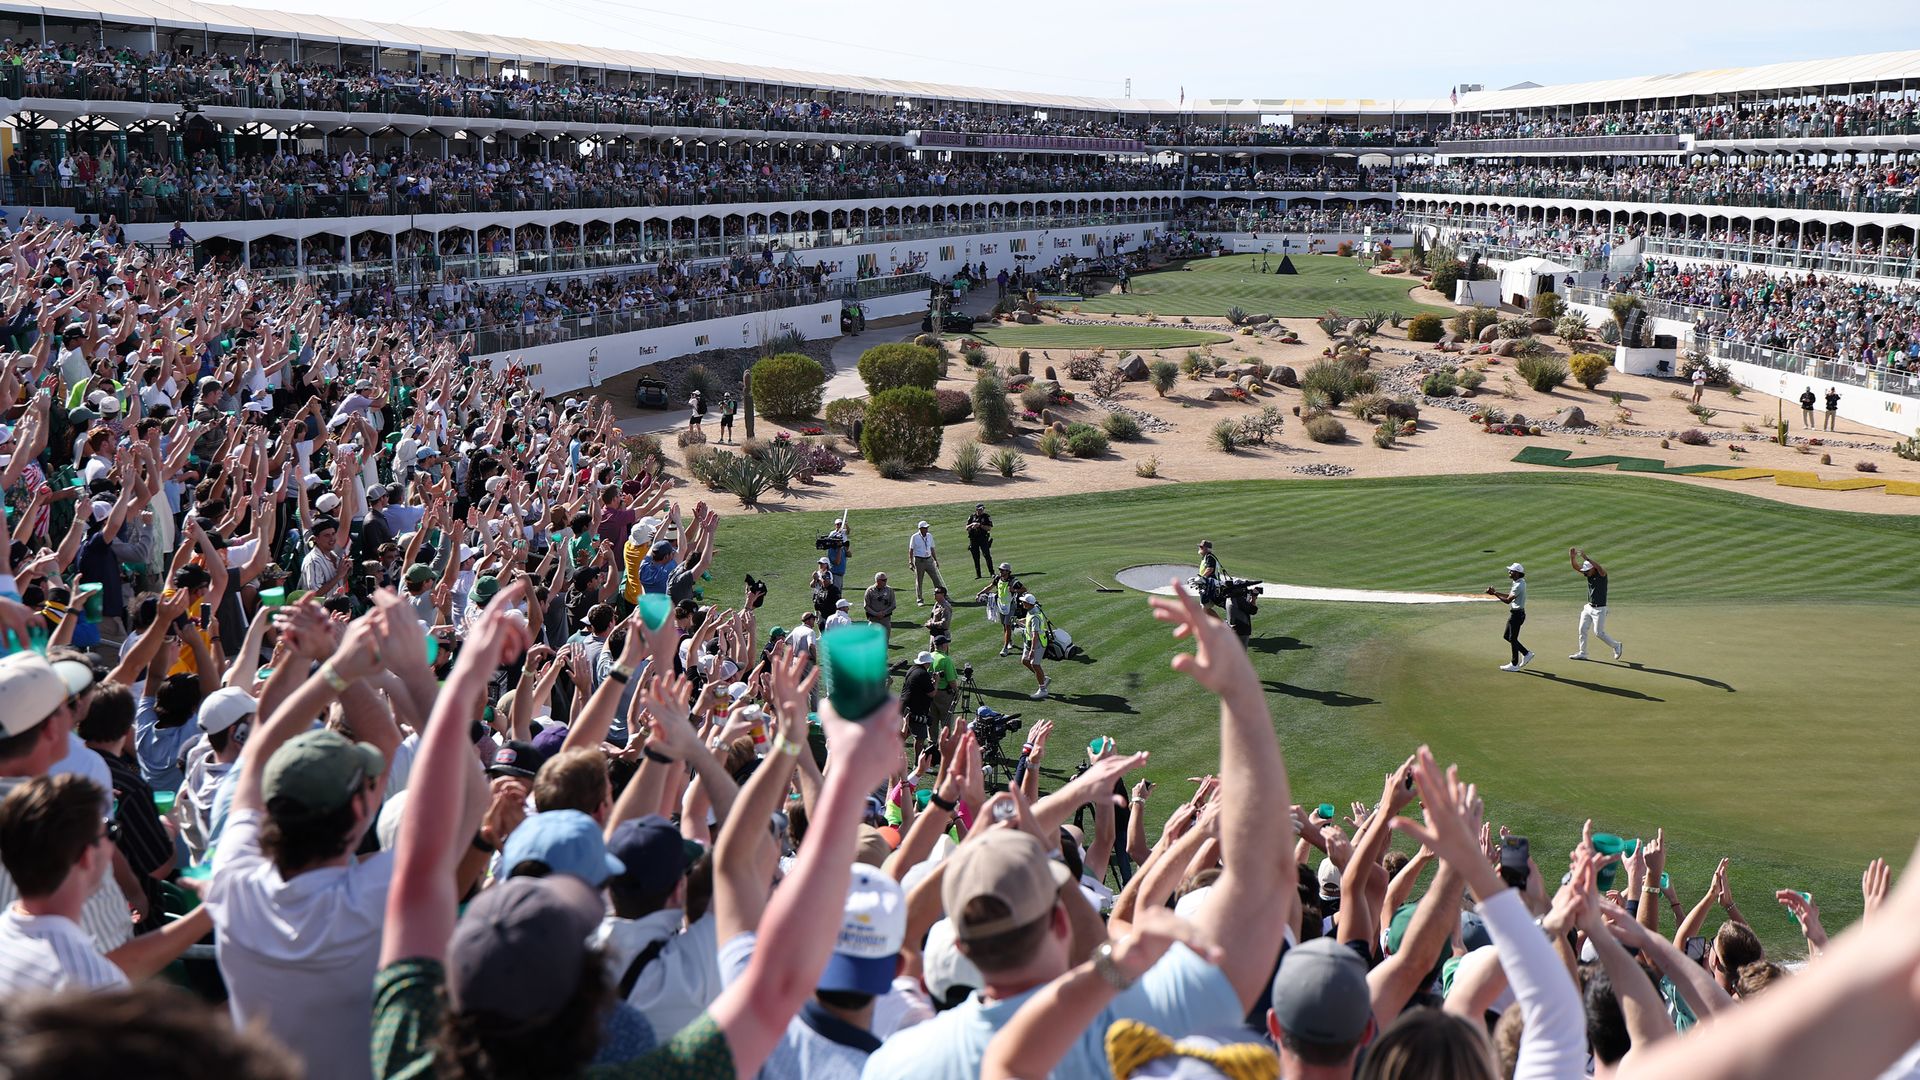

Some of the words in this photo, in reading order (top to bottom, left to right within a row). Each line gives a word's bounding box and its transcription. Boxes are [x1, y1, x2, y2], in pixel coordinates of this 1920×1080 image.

[1009, 238, 1027, 253] WM
[1082, 233, 1097, 247] WM
[939, 245, 955, 261] WM
[857, 253, 877, 269] WM
[821, 314, 832, 324] WM
[694, 334, 710, 346] WM
[523, 363, 543, 377] WM
[1885, 400, 1902, 414] WM
